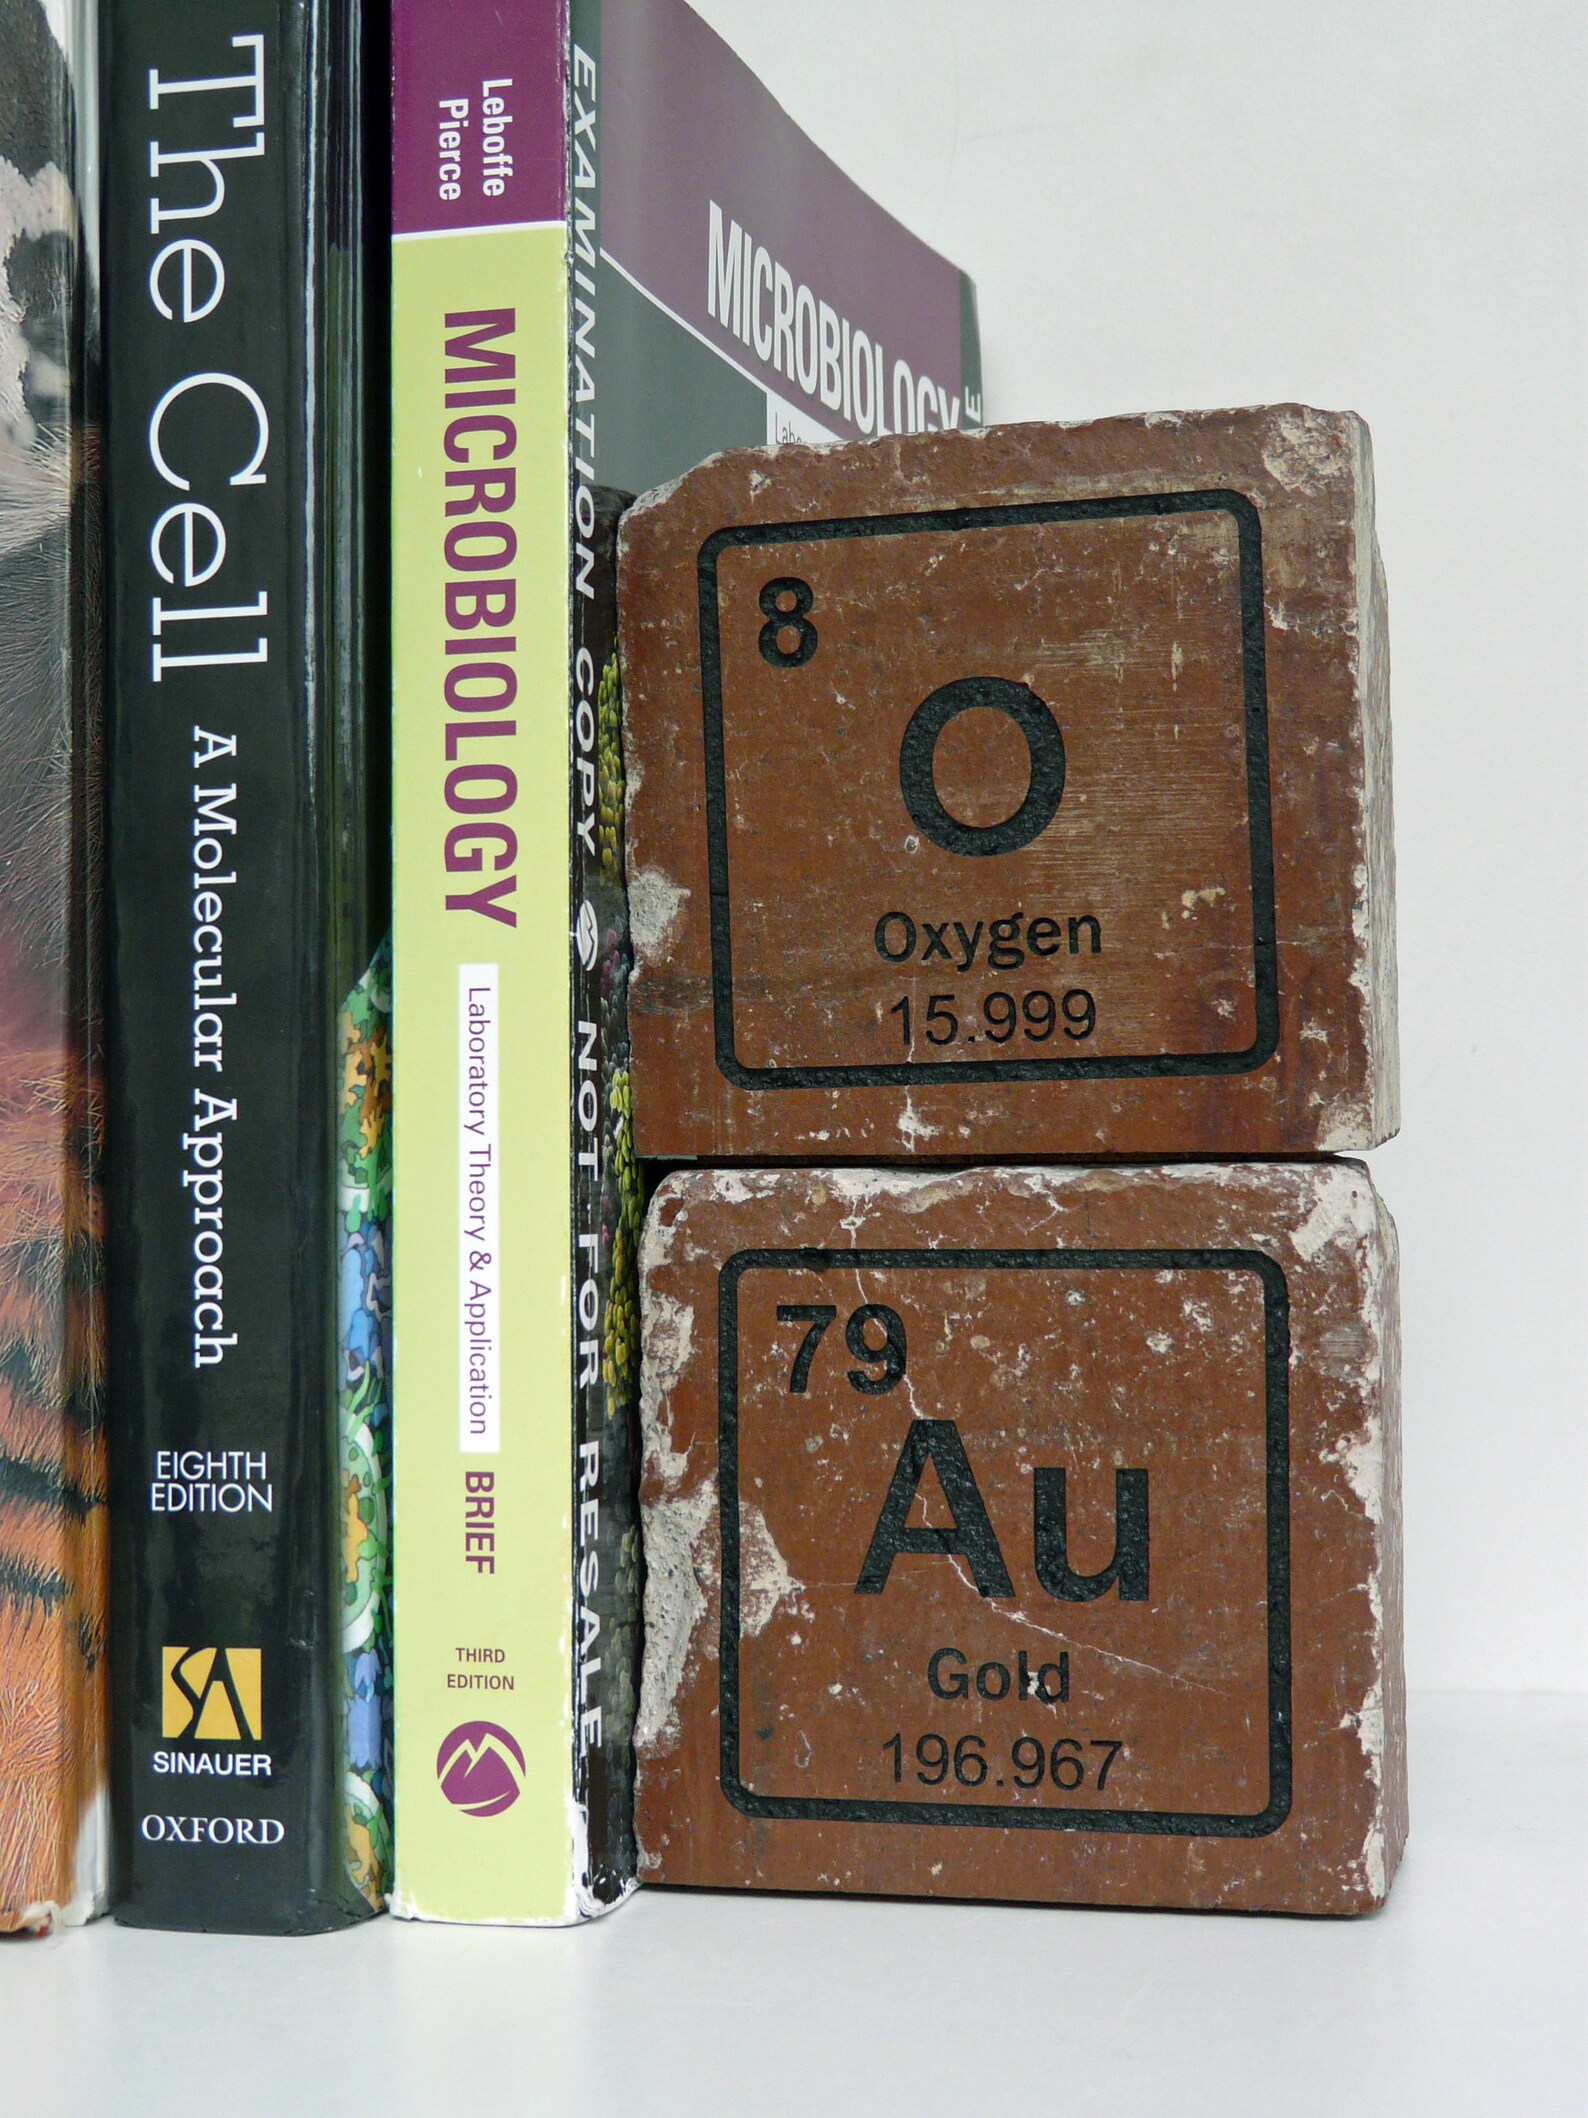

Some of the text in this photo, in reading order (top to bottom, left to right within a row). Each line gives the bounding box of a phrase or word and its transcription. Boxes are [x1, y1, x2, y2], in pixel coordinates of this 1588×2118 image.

[438, 98, 470, 201] Pierce
[482, 78, 514, 197] Leboffe
[149, 34, 269, 682] The Cell
[573, 43, 597, 856] EXAMINATION COPY
[443, 307, 518, 928] MICROBIOLOGY
[757, 576, 818, 669] 8
[900, 676, 1066, 857] O
[873, 910, 1102, 972] Oxygen
[182, 725, 238, 1369] A Molecular Approach
[890, 988, 1097, 1046] 15.999
[463, 987, 492, 1434] Laboratory Theory & Application
[576, 1019, 603, 1759] NOT FOR RESALE
[776, 1303, 908, 1396] 79
[150, 1482, 273, 1513] EDITION
[157, 1450, 267, 1481] EIGHTH
[853, 1419, 1151, 1602] Au
[465, 1471, 495, 1574] BRIEF
[446, 1673, 515, 1691] EDITION
[455, 1647, 506, 1664] THIRD
[927, 1648, 1070, 1704] Gold
[153, 1750, 272, 1776] SINAUER
[883, 1732, 1123, 1791] 196.967
[141, 1814, 285, 1845] OXFORD
